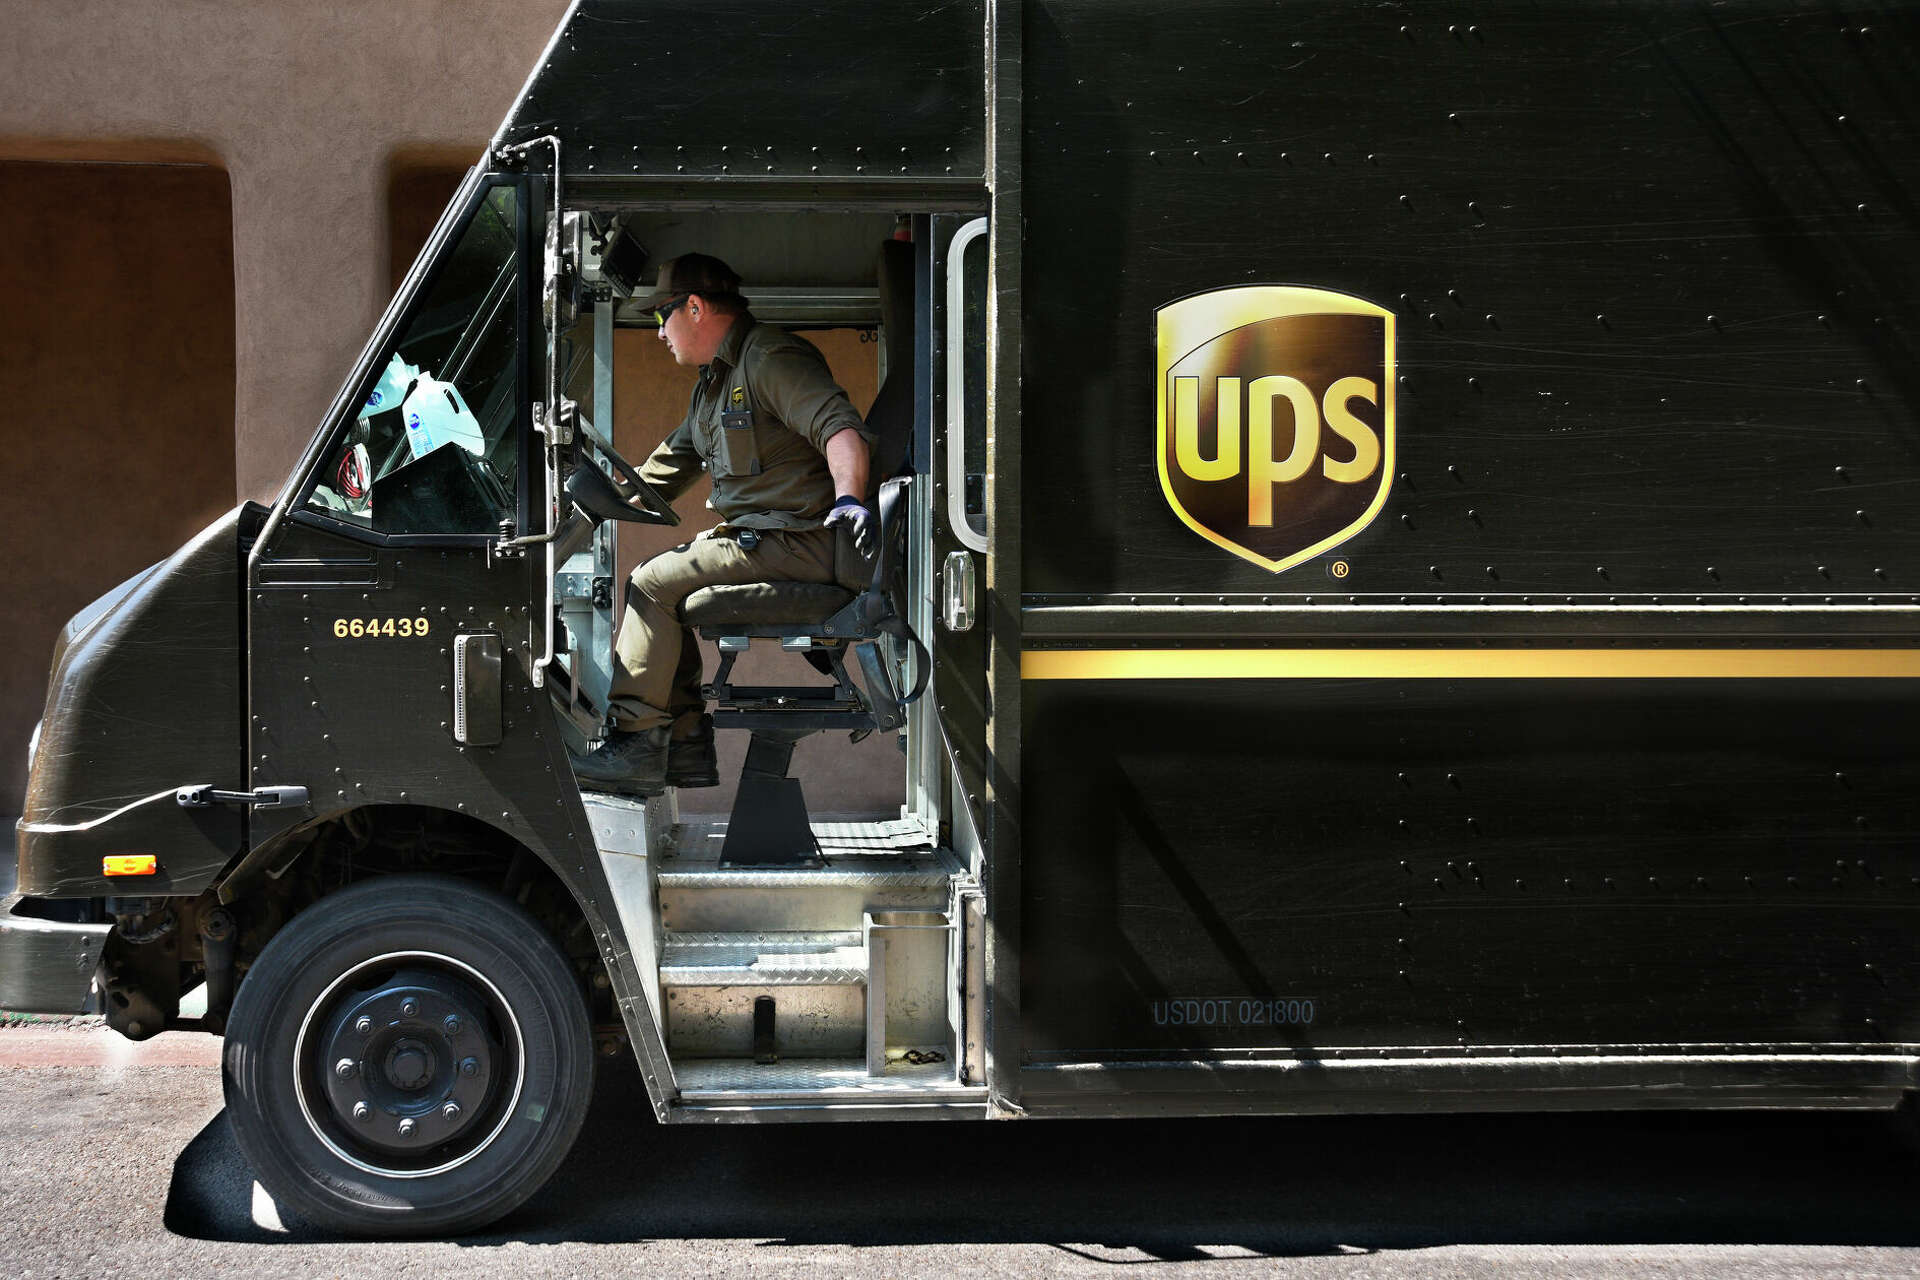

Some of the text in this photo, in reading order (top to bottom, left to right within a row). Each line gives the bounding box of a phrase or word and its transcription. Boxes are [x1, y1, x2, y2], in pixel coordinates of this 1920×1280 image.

[1174, 375, 1380, 527] ups
[333, 617, 430, 638] 664439
[1153, 999, 1314, 1025] USDOT 021800
